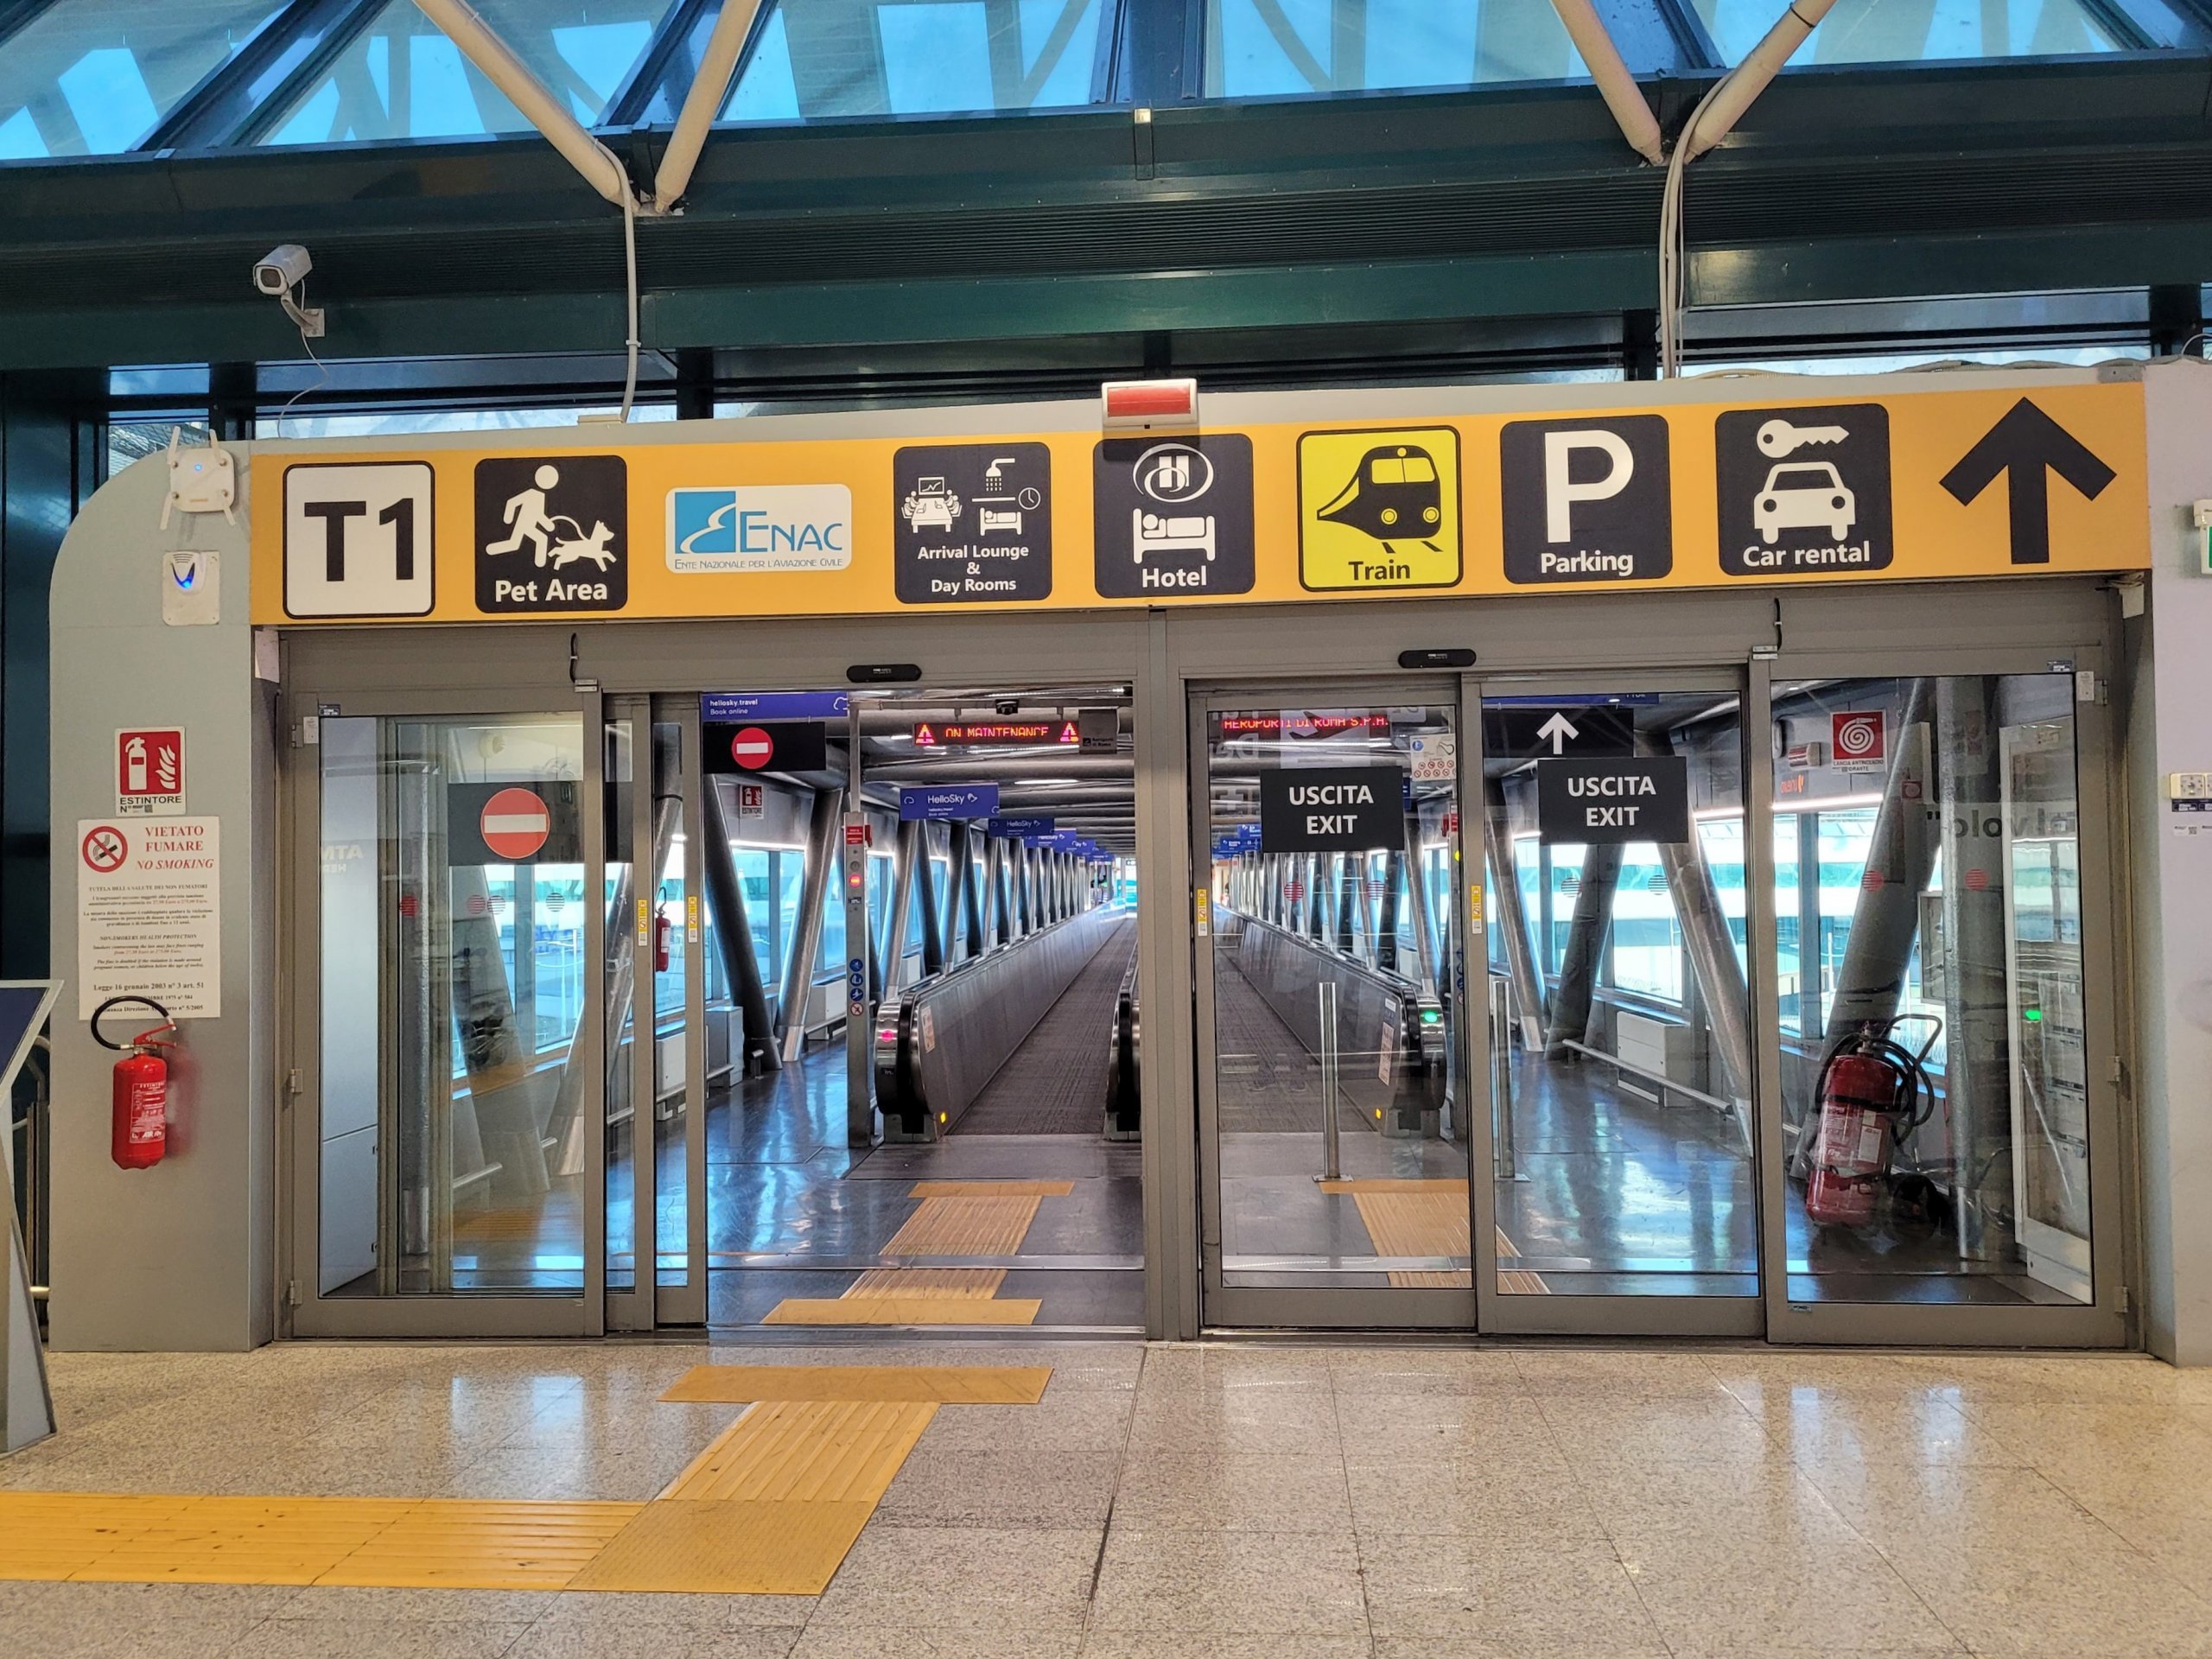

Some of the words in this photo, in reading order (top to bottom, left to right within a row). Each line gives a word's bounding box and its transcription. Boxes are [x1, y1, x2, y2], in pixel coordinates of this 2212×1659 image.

[1545, 429, 1633, 543] P
[304, 497, 414, 582] T1
[740, 512, 842, 552] ENAC
[918, 545, 968, 560] Arrival
[972, 544, 1029, 561] Lounge
[1743, 546, 1787, 567] Car
[1794, 541, 1870, 563] rental
[967, 562, 980, 575] &
[1349, 560, 1411, 581] Train
[1541, 551, 1633, 576] Parking
[931, 579, 960, 595] Day
[965, 578, 1016, 591] Rooms
[1142, 566, 1206, 588] Hotel
[495, 578, 538, 602] Pet
[544, 579, 608, 601] Area
[710, 698, 758, 707] hellosky.travel
[1289, 785, 1374, 805] USCITA
[1567, 776, 1656, 797] USCITA
[120, 796, 181, 804] ESTINTORE
[928, 794, 964, 804] HelloSky
[1306, 815, 1357, 835] EXIT
[1586, 807, 1639, 826] EXIT
[145, 826, 204, 836] VIETATO
[146, 841, 203, 852] FUMARE
[137, 861, 153, 870] NO
[156, 859, 213, 869] SMOKING
